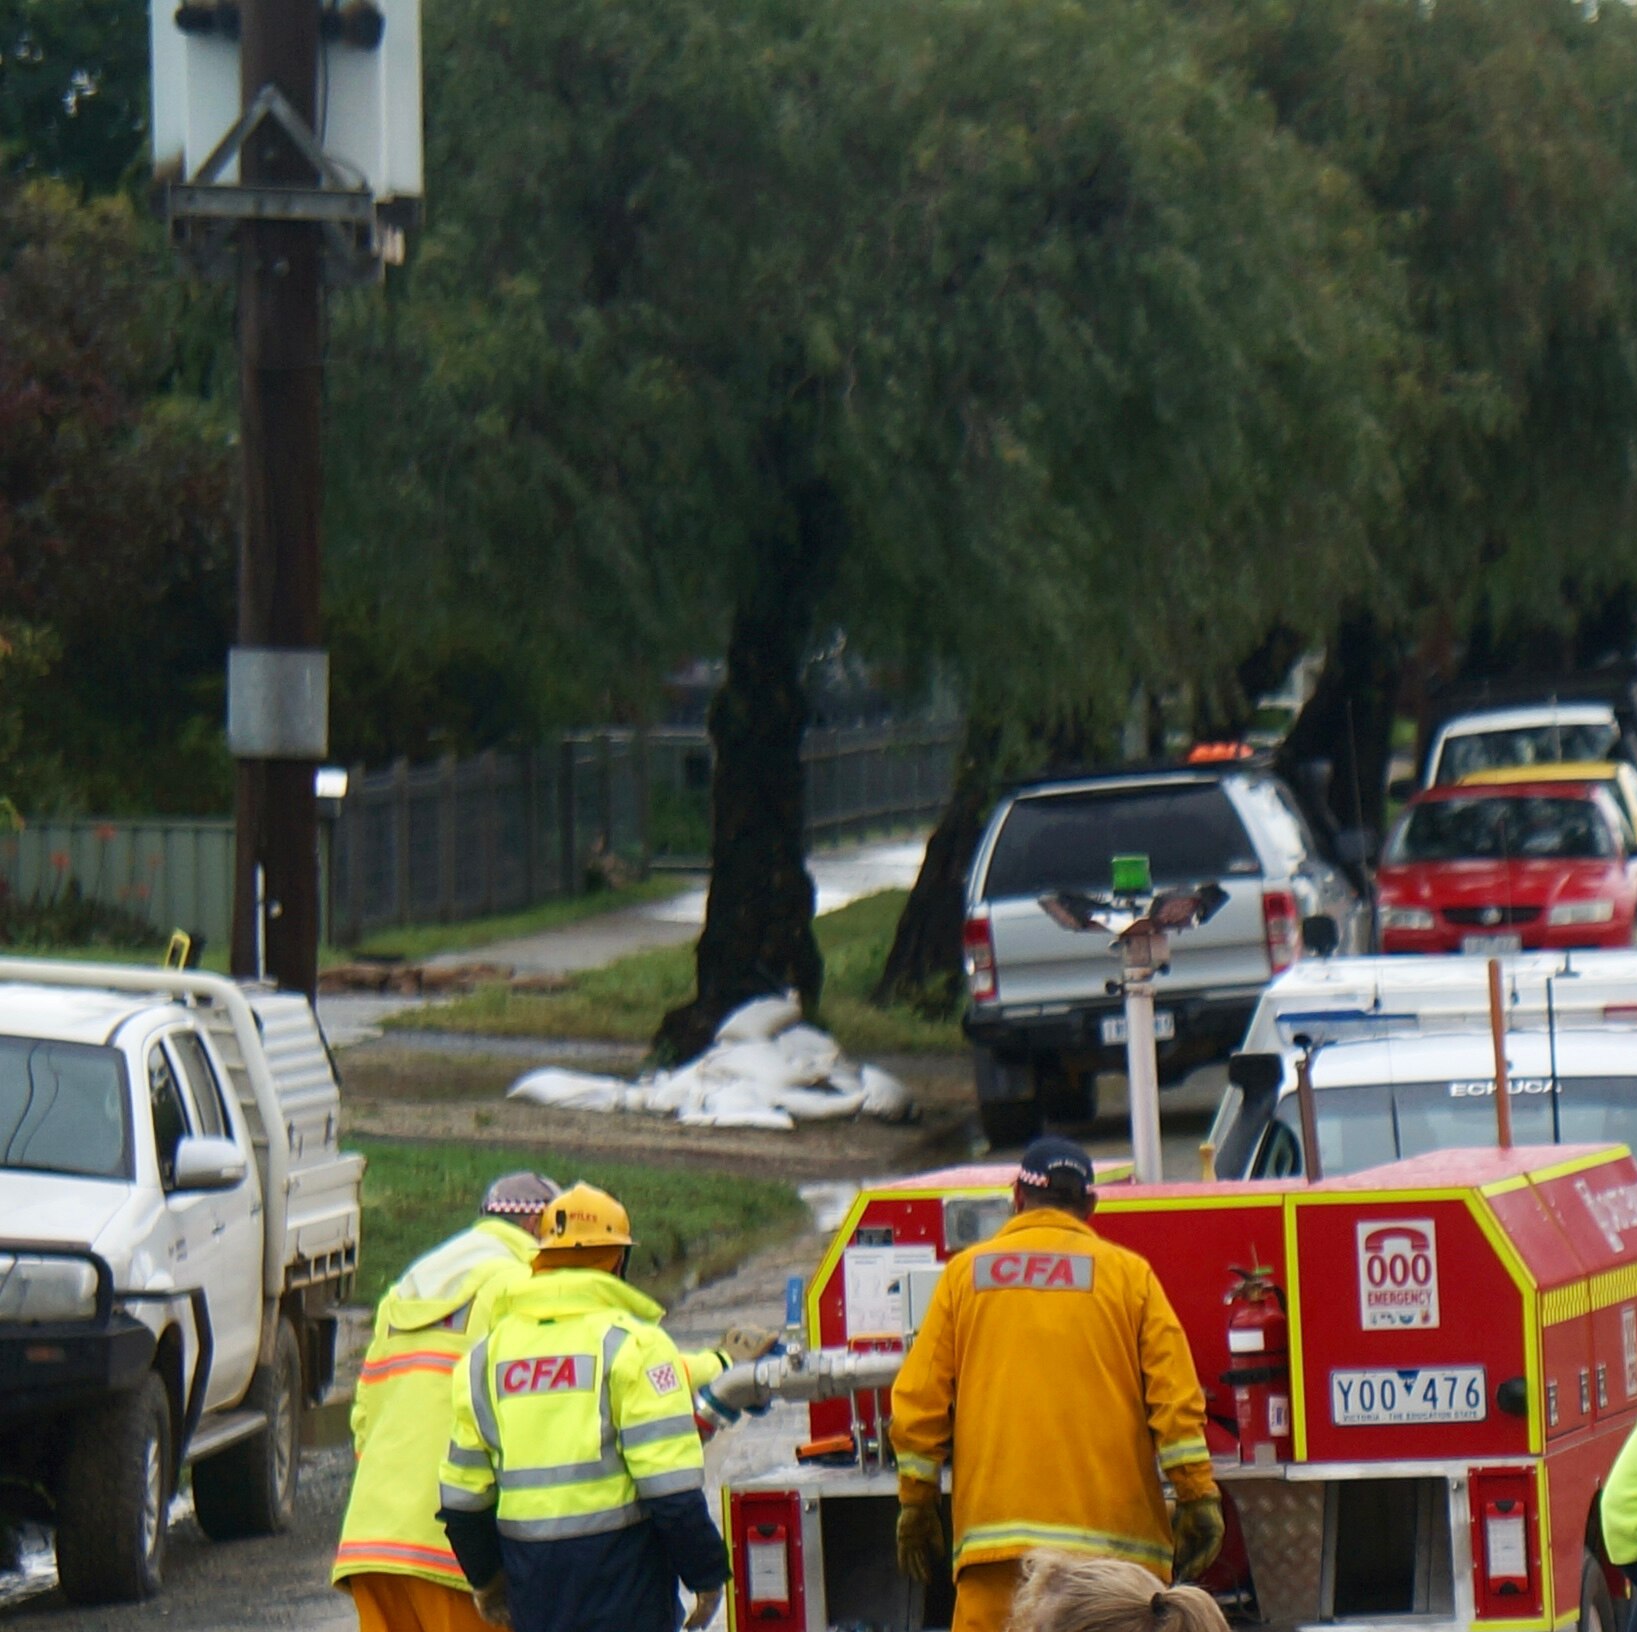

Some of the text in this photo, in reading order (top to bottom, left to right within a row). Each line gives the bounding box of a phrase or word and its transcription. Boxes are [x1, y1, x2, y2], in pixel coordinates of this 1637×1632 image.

[990, 1255, 1075, 1286] CFA
[1367, 1253, 1432, 1289] 000
[1368, 1289, 1433, 1307] EMERGENCY
[503, 1356, 577, 1395] CFA
[1422, 1376, 1481, 1410] 476
[1343, 1413, 1379, 1422] VICTORIA
